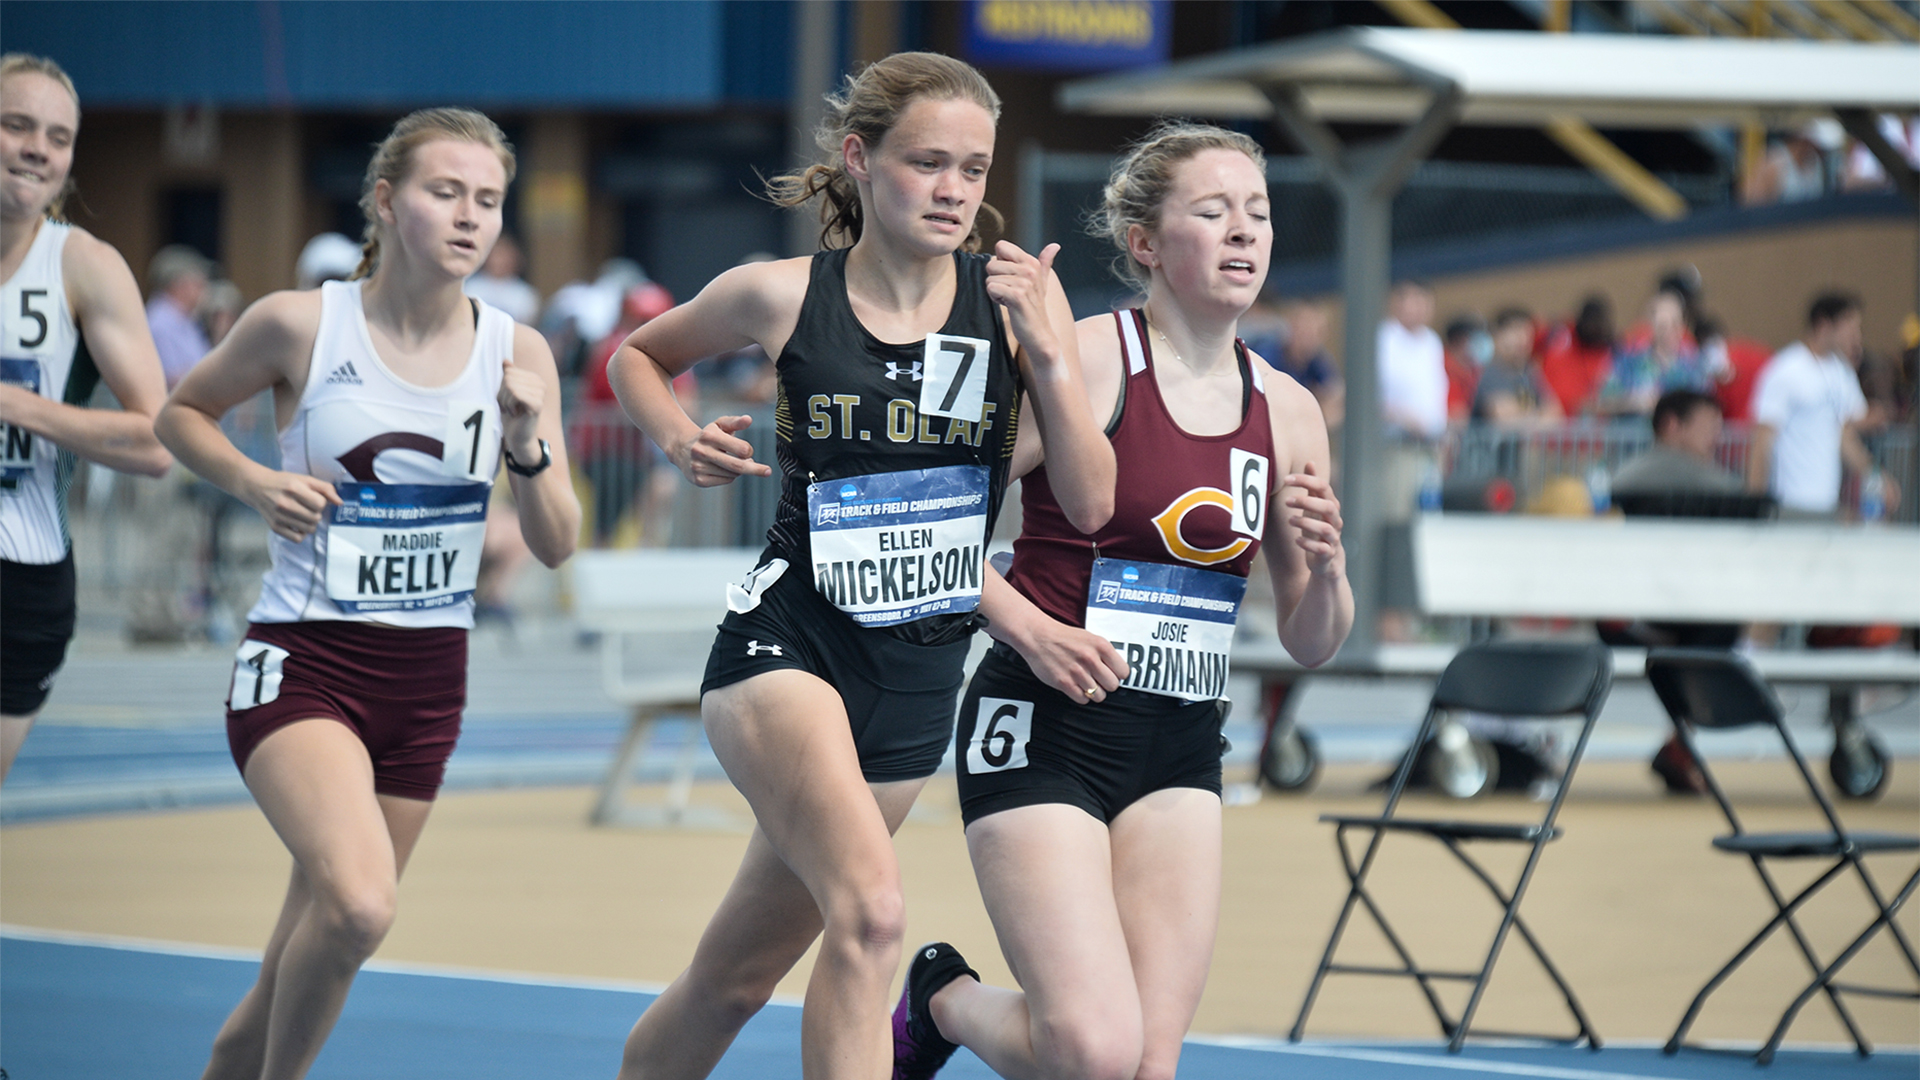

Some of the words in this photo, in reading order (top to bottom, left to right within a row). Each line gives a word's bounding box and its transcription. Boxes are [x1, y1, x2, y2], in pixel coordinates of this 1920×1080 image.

[19, 289, 48, 348] 5
[938, 340, 976, 412] 7
[463, 410, 483, 474] 1
[808, 394, 871, 440] ST.
[359, 507, 388, 519] TRACK
[841, 503, 873, 518] TRACK
[873, 503, 881, 515] &
[881, 501, 909, 515] FIELD
[910, 494, 983, 513] CHAMPIONSHIPS
[1241, 458, 1261, 532] 6
[382, 531, 443, 551] MADDIE
[879, 528, 933, 552] ELLEN
[1151, 486, 1253, 566] C
[357, 549, 460, 595] KELLY
[816, 544, 980, 606] MICKELSON
[1119, 588, 1151, 603] TRACK
[1158, 592, 1181, 606] FIELD
[1152, 621, 1189, 643] JOSIE
[248, 649, 270, 704] 1
[1110, 641, 1227, 698] RRMANN
[981, 704, 1020, 768] 6
